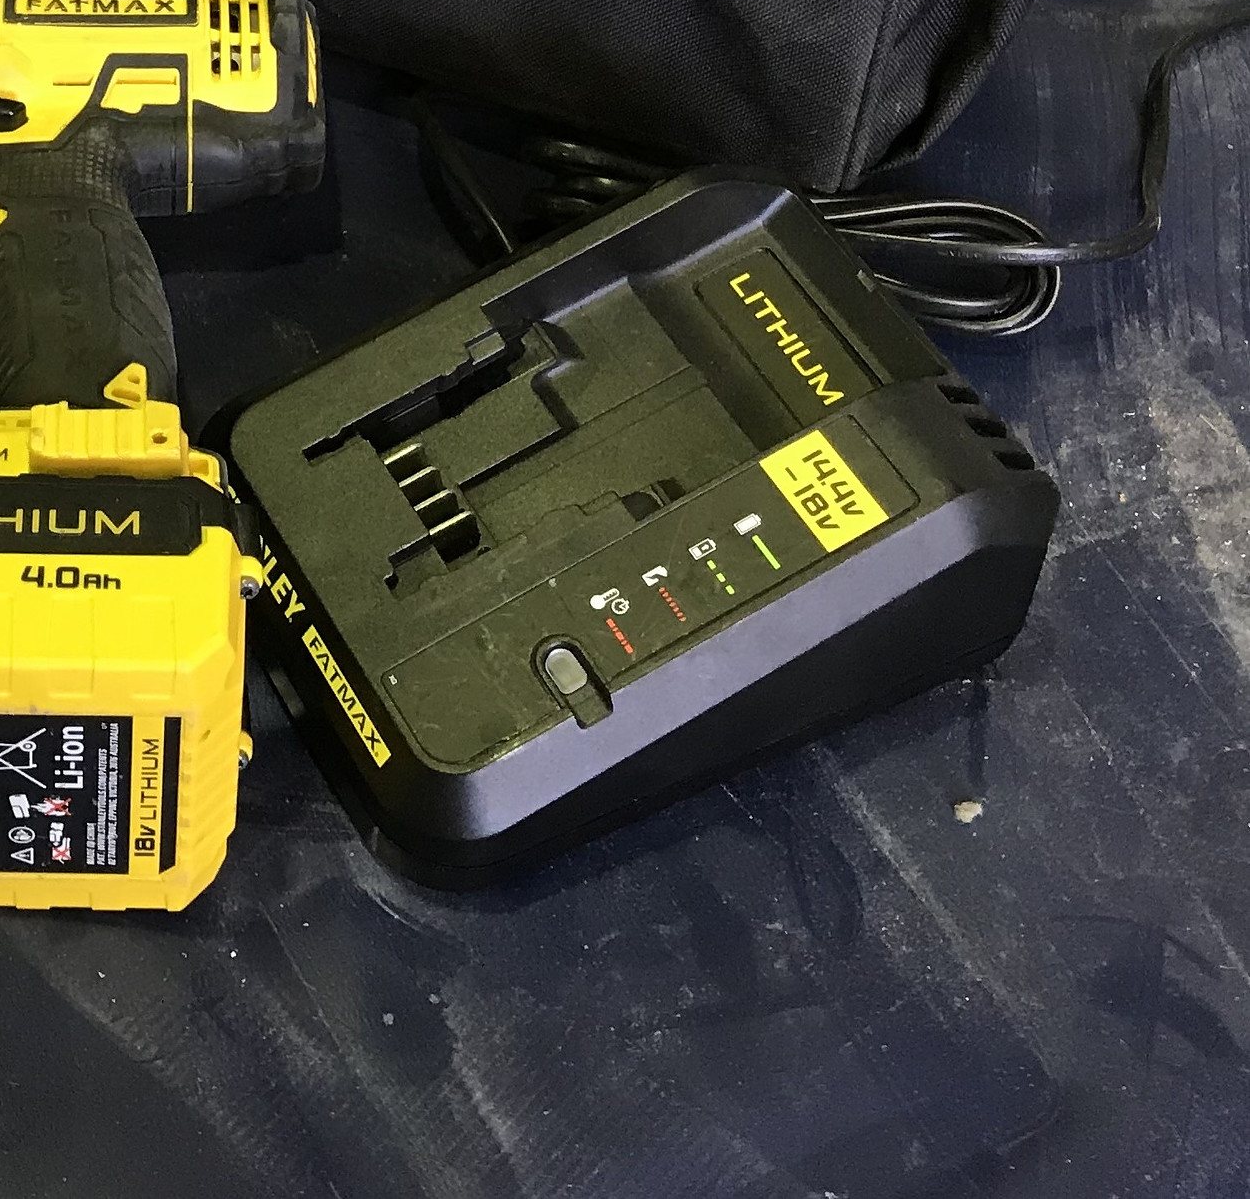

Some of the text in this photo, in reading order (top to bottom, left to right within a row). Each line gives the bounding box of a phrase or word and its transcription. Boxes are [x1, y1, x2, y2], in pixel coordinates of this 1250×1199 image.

[728, 272, 846, 406] LITHIUM
[54, 725, 84, 789] Li-ion
[139, 738, 160, 821] LITHIUM
